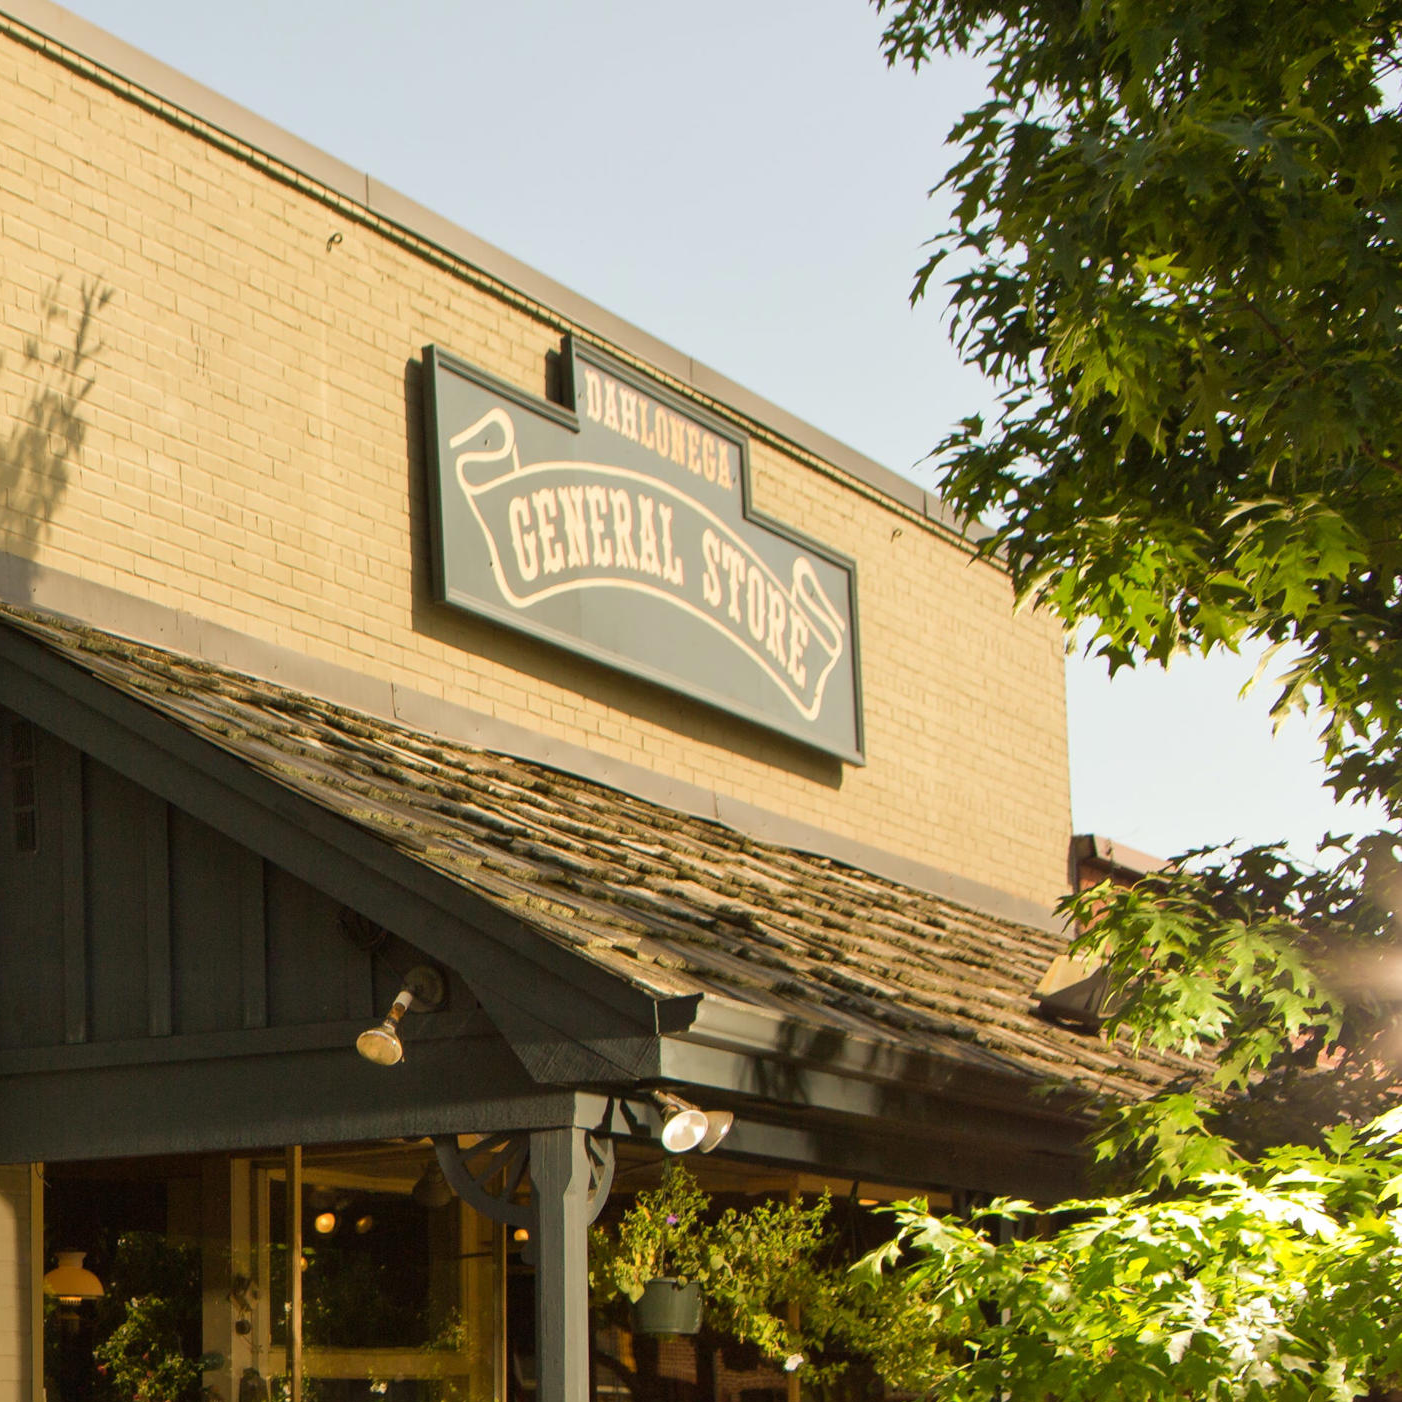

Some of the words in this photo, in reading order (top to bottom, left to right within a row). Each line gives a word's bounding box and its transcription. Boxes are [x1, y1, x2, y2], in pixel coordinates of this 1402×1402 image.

[584, 368, 734, 491] DAHLONEGA
[508, 484, 684, 587] GENERAL
[702, 528, 811, 690] STORE
